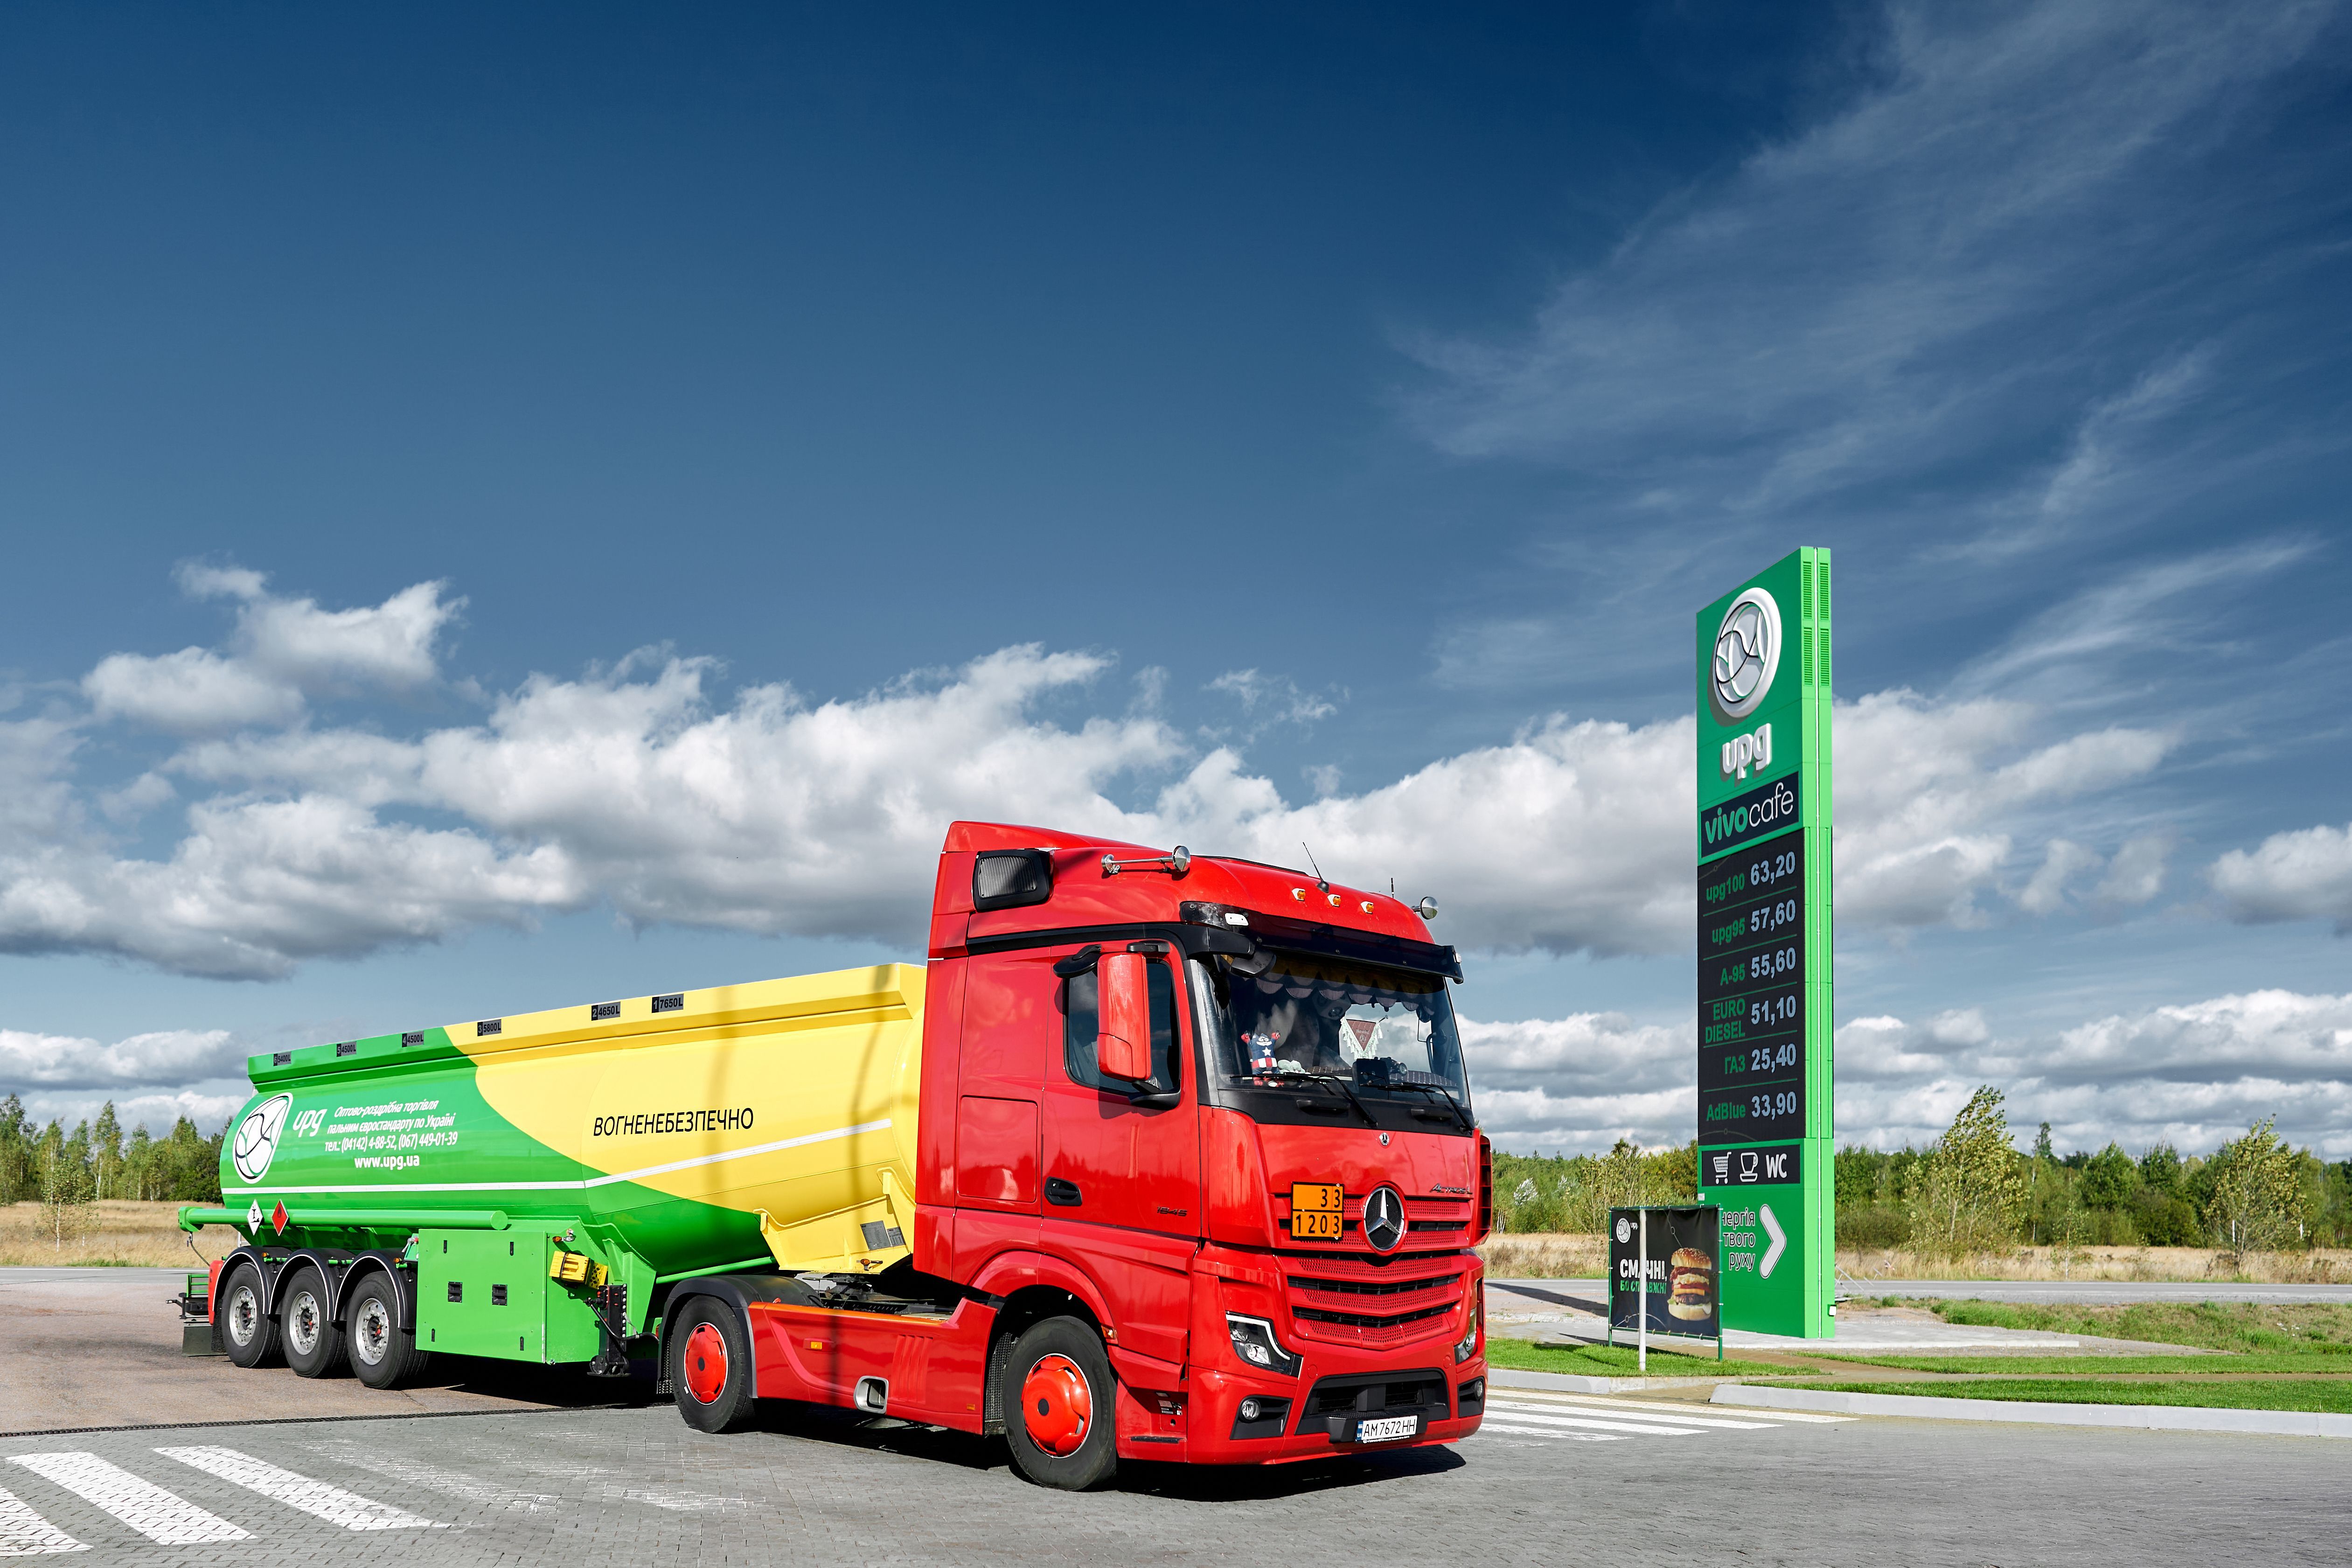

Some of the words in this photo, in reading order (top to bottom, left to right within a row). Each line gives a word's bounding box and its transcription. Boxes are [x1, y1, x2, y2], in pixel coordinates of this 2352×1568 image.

[1722, 723, 1772, 780] upg
[1706, 873, 1745, 903] upg100
[1750, 851, 1795, 885] 63,20
[1712, 918, 1746, 945] upg95
[1750, 899, 1796, 932] 57,60
[1720, 963, 1746, 986] А-95
[1751, 947, 1796, 979] 55,60
[592, 1008, 597, 1018] 2
[598, 1005, 620, 1016] 4650L
[653, 999, 658, 1010] 1
[660, 997, 683, 1009] 7650L
[1713, 998, 1746, 1021] EURO
[1751, 995, 1796, 1026] 51,10
[483, 1022, 501, 1032] 5800L
[1705, 1021, 1746, 1044] DIESEL
[341, 1043, 356, 1053] 4500L
[407, 1034, 424, 1044] 4500L
[1725, 1054, 1746, 1075] ГАЗ
[1751, 1043, 1796, 1073] 25,40
[334, 1100, 403, 1118] Оптово-роздрібна
[403, 1099, 439, 1114] торгівля
[1706, 1102, 1746, 1122] AdBlue
[1751, 1091, 1796, 1120] 33,90
[292, 1108, 327, 1137] upg
[327, 1122, 359, 1135] пальним
[359, 1118, 415, 1135] євростандарту
[413, 1118, 425, 1129] по
[424, 1113, 456, 1130] Україні
[593, 1108, 753, 1136] ВОГНЕНЕБЕЗПЕЧНО
[341, 1136, 368, 1153] (04142)
[369, 1135, 397, 1150] 4-88-52,
[398, 1133, 418, 1150] (067)
[419, 1131, 458, 1147] 449-01-39
[354, 1155, 420, 1171] www.upg.ua
[1766, 1153, 1788, 1178] WC
[1157, 1206, 1188, 1217] 1845
[1722, 1207, 1755, 1230] нергія
[1296, 1214, 1340, 1234] 1203
[1723, 1233, 1755, 1247] твого
[1620, 1259, 1667, 1282] СМЧНІ,
[1729, 1253, 1755, 1271] руху
[1620, 1280, 1629, 1291] БО
[1630, 1281, 1667, 1294] СПАВЖНІ
